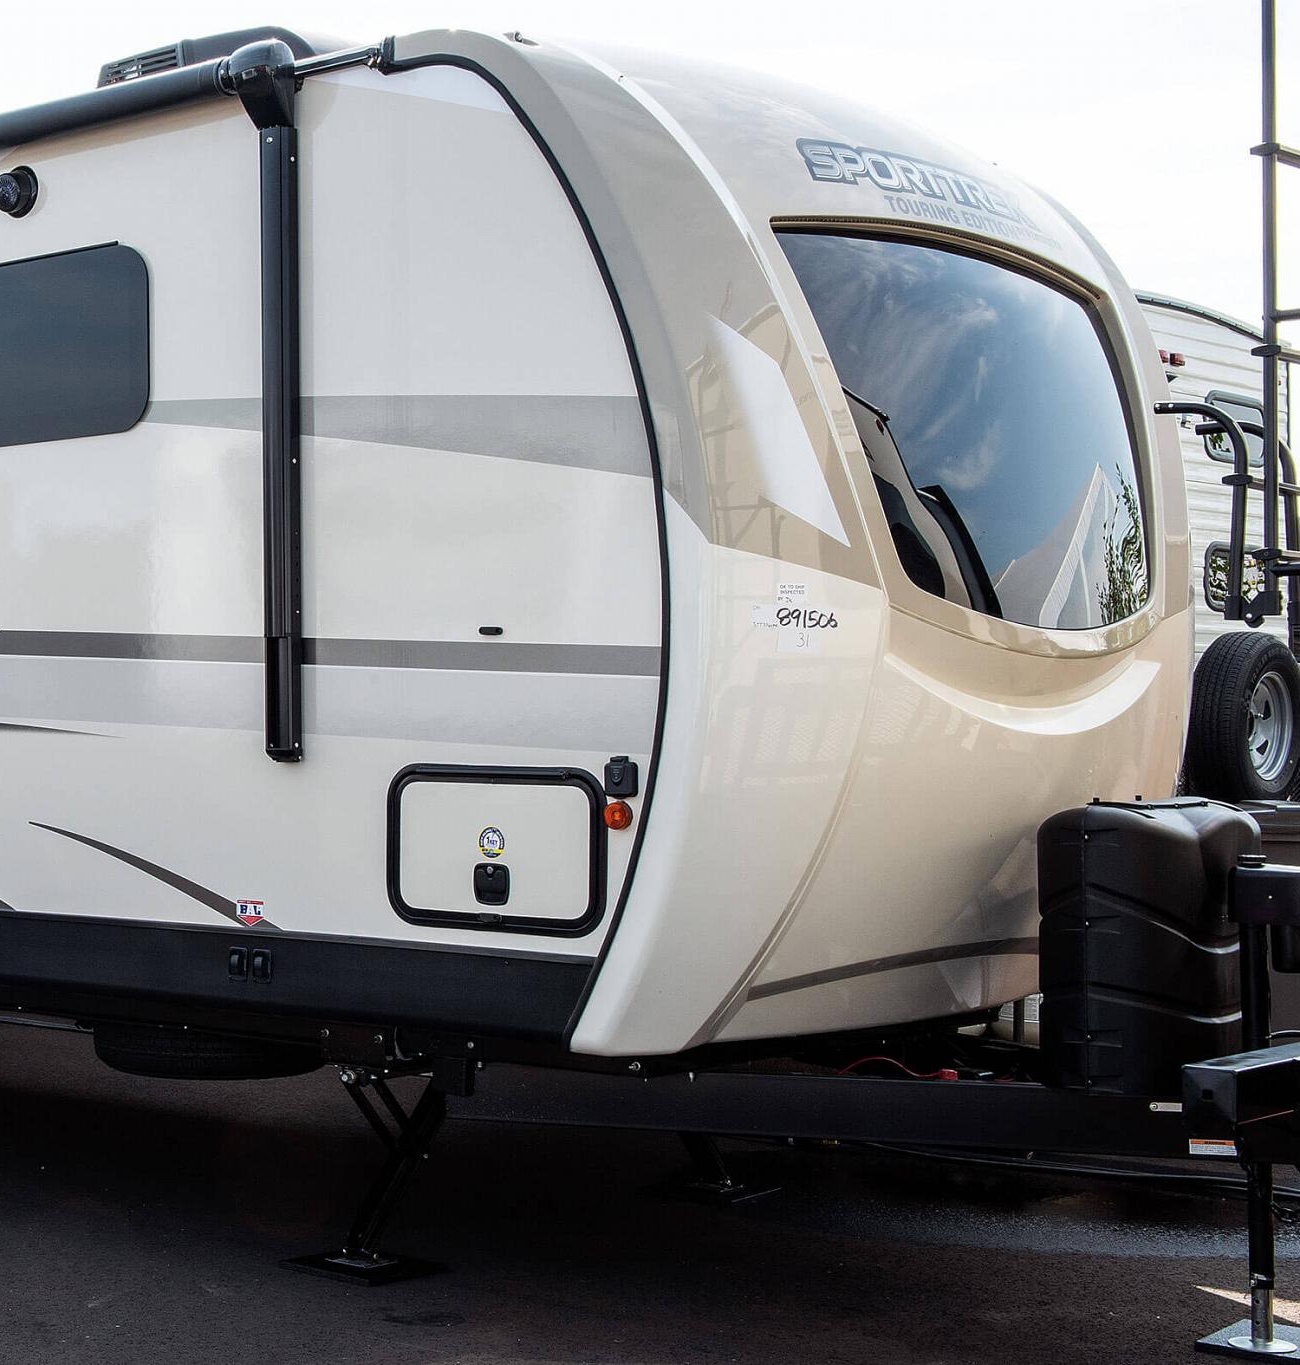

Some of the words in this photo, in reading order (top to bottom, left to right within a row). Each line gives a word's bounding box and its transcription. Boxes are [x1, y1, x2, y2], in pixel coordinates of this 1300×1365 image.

[796, 138, 1042, 234] SPORTTREK
[884, 195, 960, 225] TOURING
[776, 607, 838, 629] 891506
